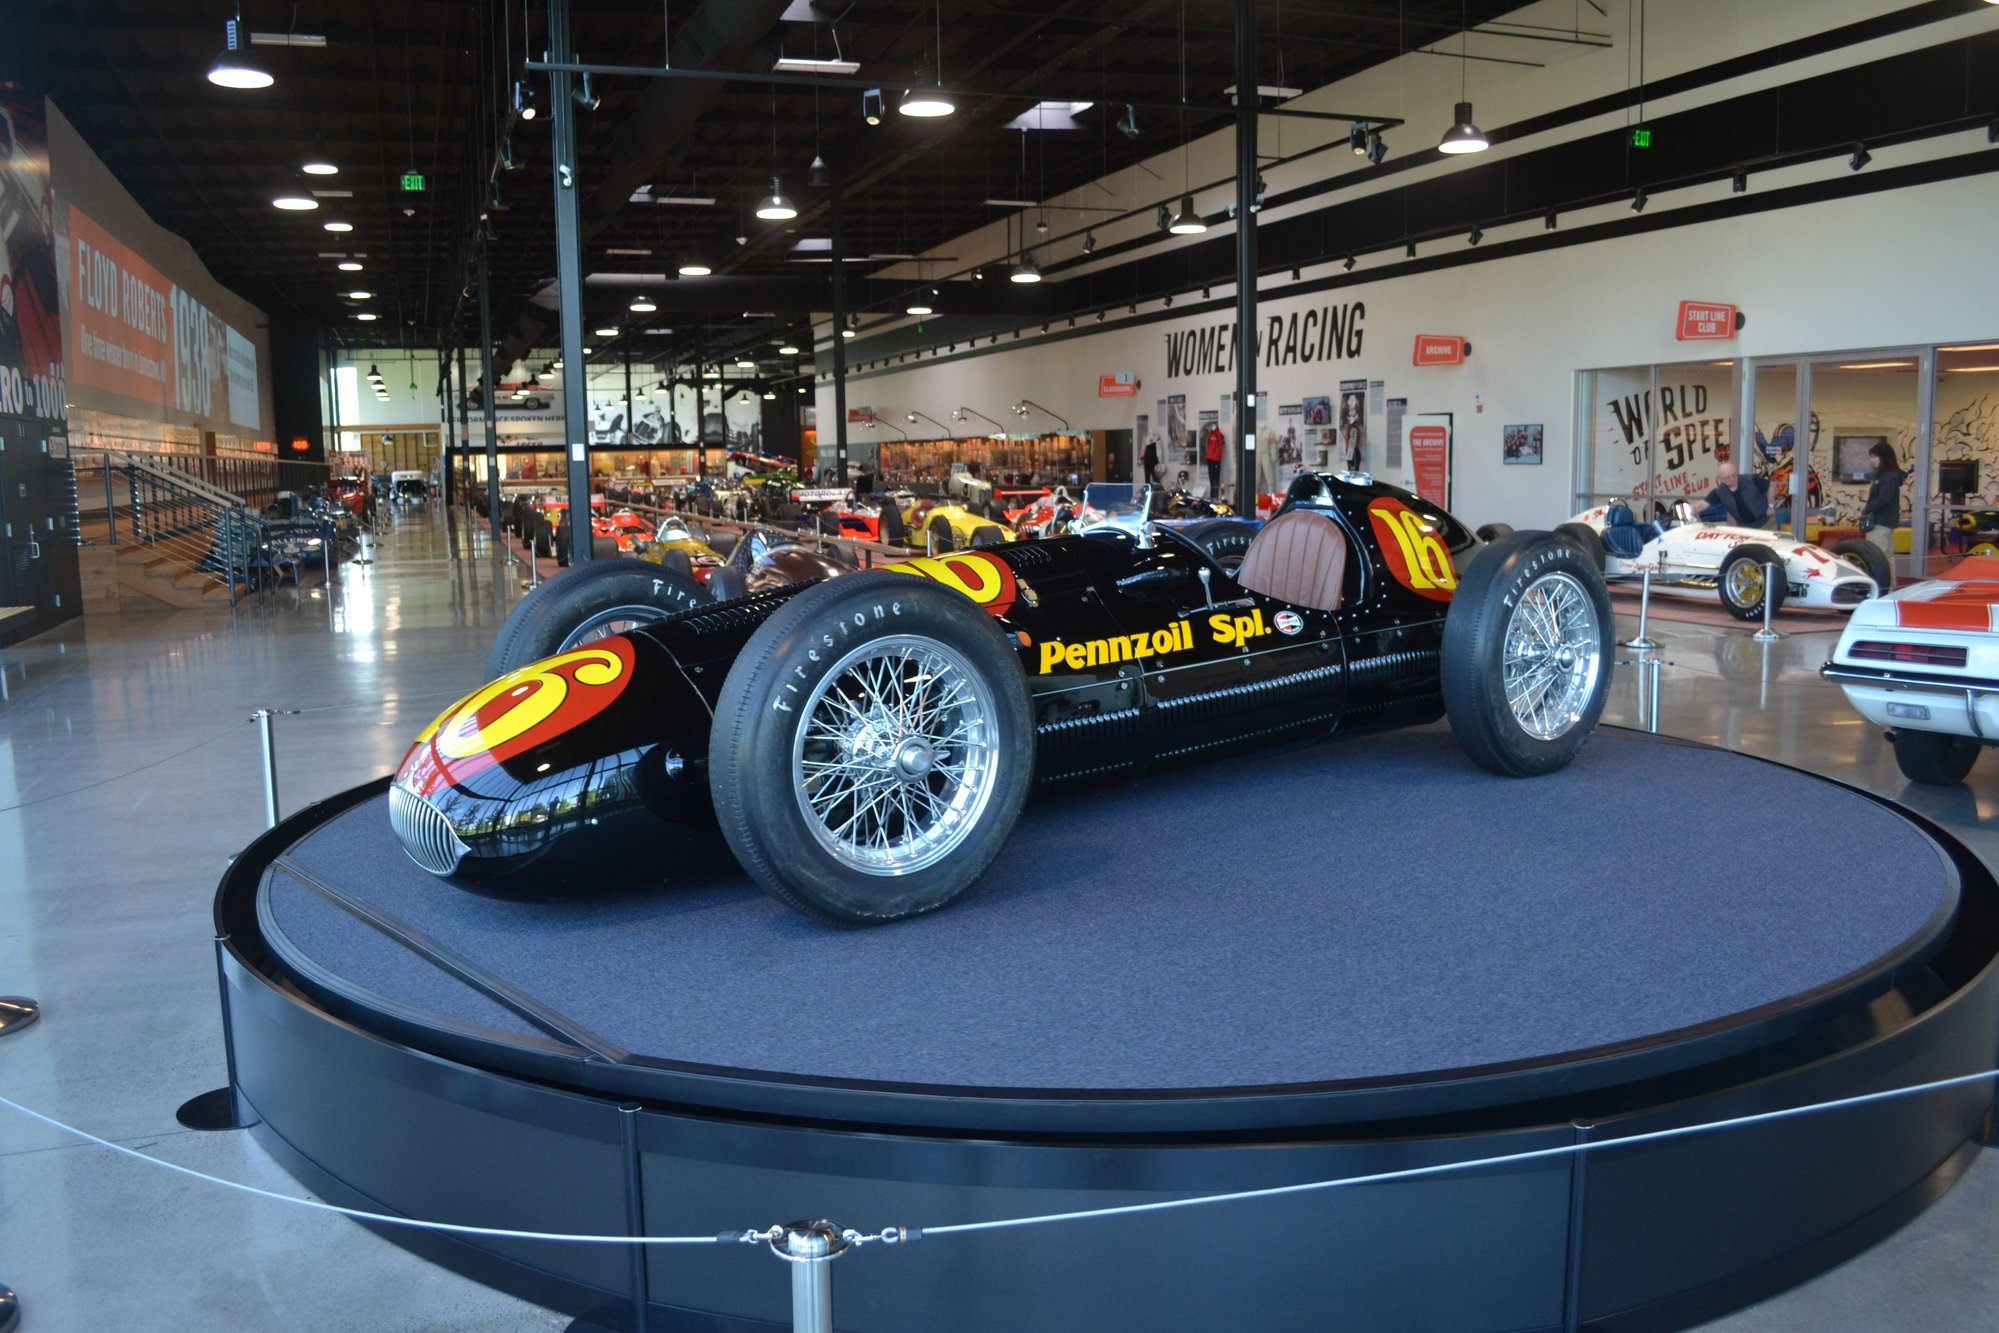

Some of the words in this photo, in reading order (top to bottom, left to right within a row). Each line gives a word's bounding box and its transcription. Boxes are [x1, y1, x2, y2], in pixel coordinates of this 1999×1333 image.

[404, 175, 423, 190] EXIT
[78, 238, 118, 318] FLOYD
[122, 269, 167, 344] ROBERTS
[1688, 310, 1709, 321] START
[1710, 311, 1726, 322] LINE
[1266, 301, 1365, 367] RACING
[1425, 345, 1452, 355] ARCHIVE
[1698, 322, 1716, 333] CLUB
[0, 364, 24, 415] RO
[25, 380, 34, 406] to
[33, 373, 68, 420] 1000
[1412, 438, 1422, 447] THE
[1422, 438, 1444, 447] ARCHIVE
[1658, 418, 1731, 471] SPEE
[1683, 477, 1710, 496] CLUB
[1369, 508, 1457, 591] 16
[1503, 548, 1571, 608] Firestone
[772, 601, 901, 712] Firestone
[1039, 620, 1194, 675] Pennzoil
[1208, 608, 1272, 648] Spl.
